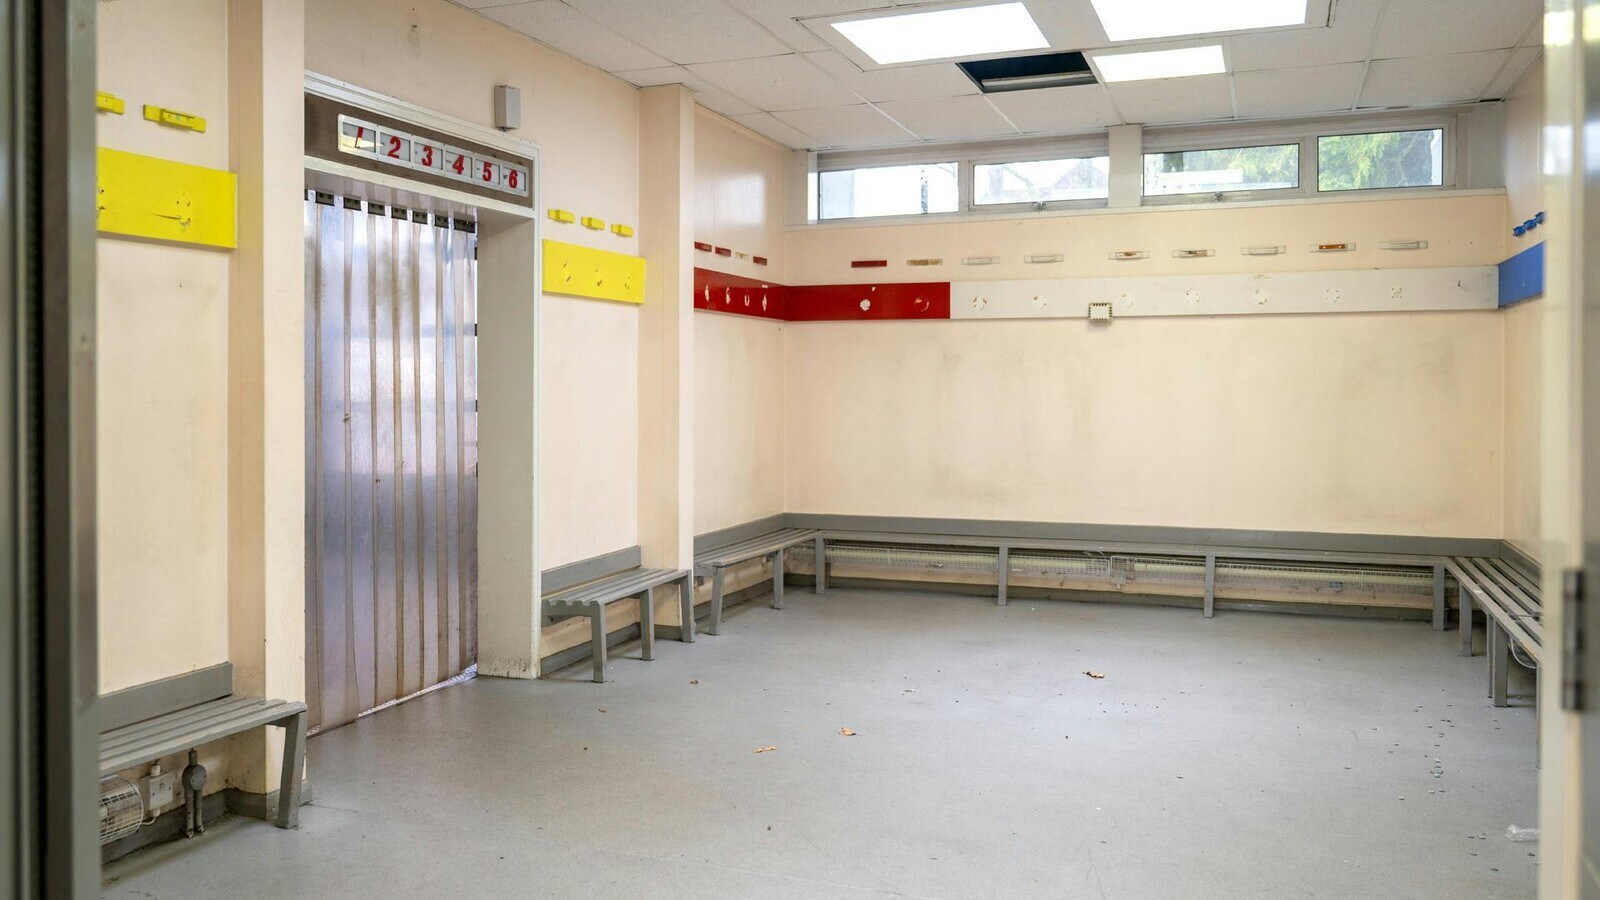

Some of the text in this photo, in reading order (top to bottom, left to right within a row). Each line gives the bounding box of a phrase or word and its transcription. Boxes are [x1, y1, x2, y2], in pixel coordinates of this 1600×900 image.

[387, 136, 402, 159] 2
[421, 145, 433, 167] 3
[452, 154, 464, 175] 4
[482, 161, 493, 182] 5
[508, 169, 518, 189] 6
